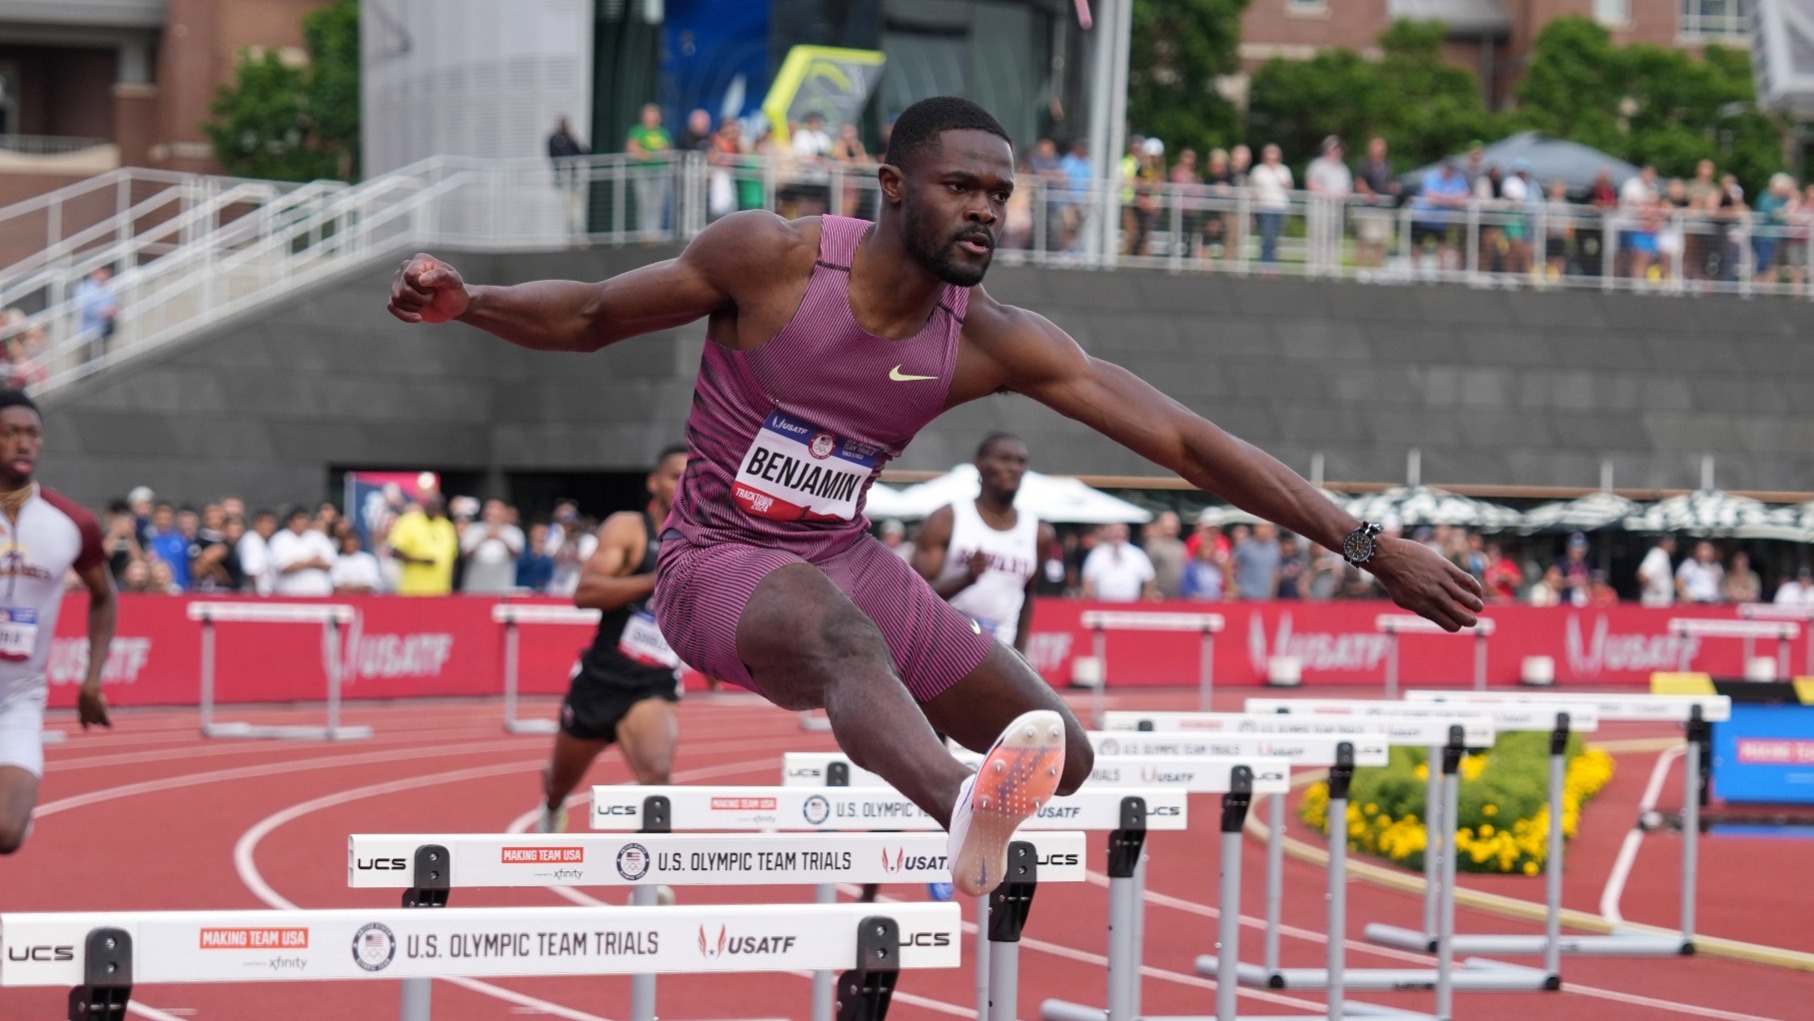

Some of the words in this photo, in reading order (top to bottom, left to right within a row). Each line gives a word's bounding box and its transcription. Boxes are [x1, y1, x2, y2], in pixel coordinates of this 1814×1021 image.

[782, 422, 808, 435] USATF
[746, 447, 861, 502] BENJAMIN
[360, 633, 454, 678] USATF
[1157, 772, 1195, 783] USATF
[597, 805, 637, 815] UCS
[836, 802, 859, 817] U.S.
[863, 802, 913, 818] OLYMPIC
[1037, 807, 1081, 818] USATF
[503, 850, 537, 862] MAKING
[538, 850, 562, 861] TEAM
[562, 850, 582, 861] USA
[657, 852, 686, 873] U.S.
[690, 852, 753, 872] OLYMPIC
[758, 851, 796, 871] TEAM
[801, 850, 852, 871] TRIALS
[904, 855, 950, 871] USAT
[357, 858, 407, 871] UCS
[552, 868, 584, 880] xfinity
[202, 930, 248, 947] MAKING
[248, 930, 279, 946] TEAM
[281, 930, 306, 946] USA
[406, 934, 443, 959] U.S.
[449, 933, 531, 958] OLYMPIC
[537, 932, 588, 957] TEAM
[594, 931, 659, 956] TRIALS
[727, 935, 797, 955] USATF
[7, 944, 75, 962] UCS
[268, 955, 308, 971] xfinity
